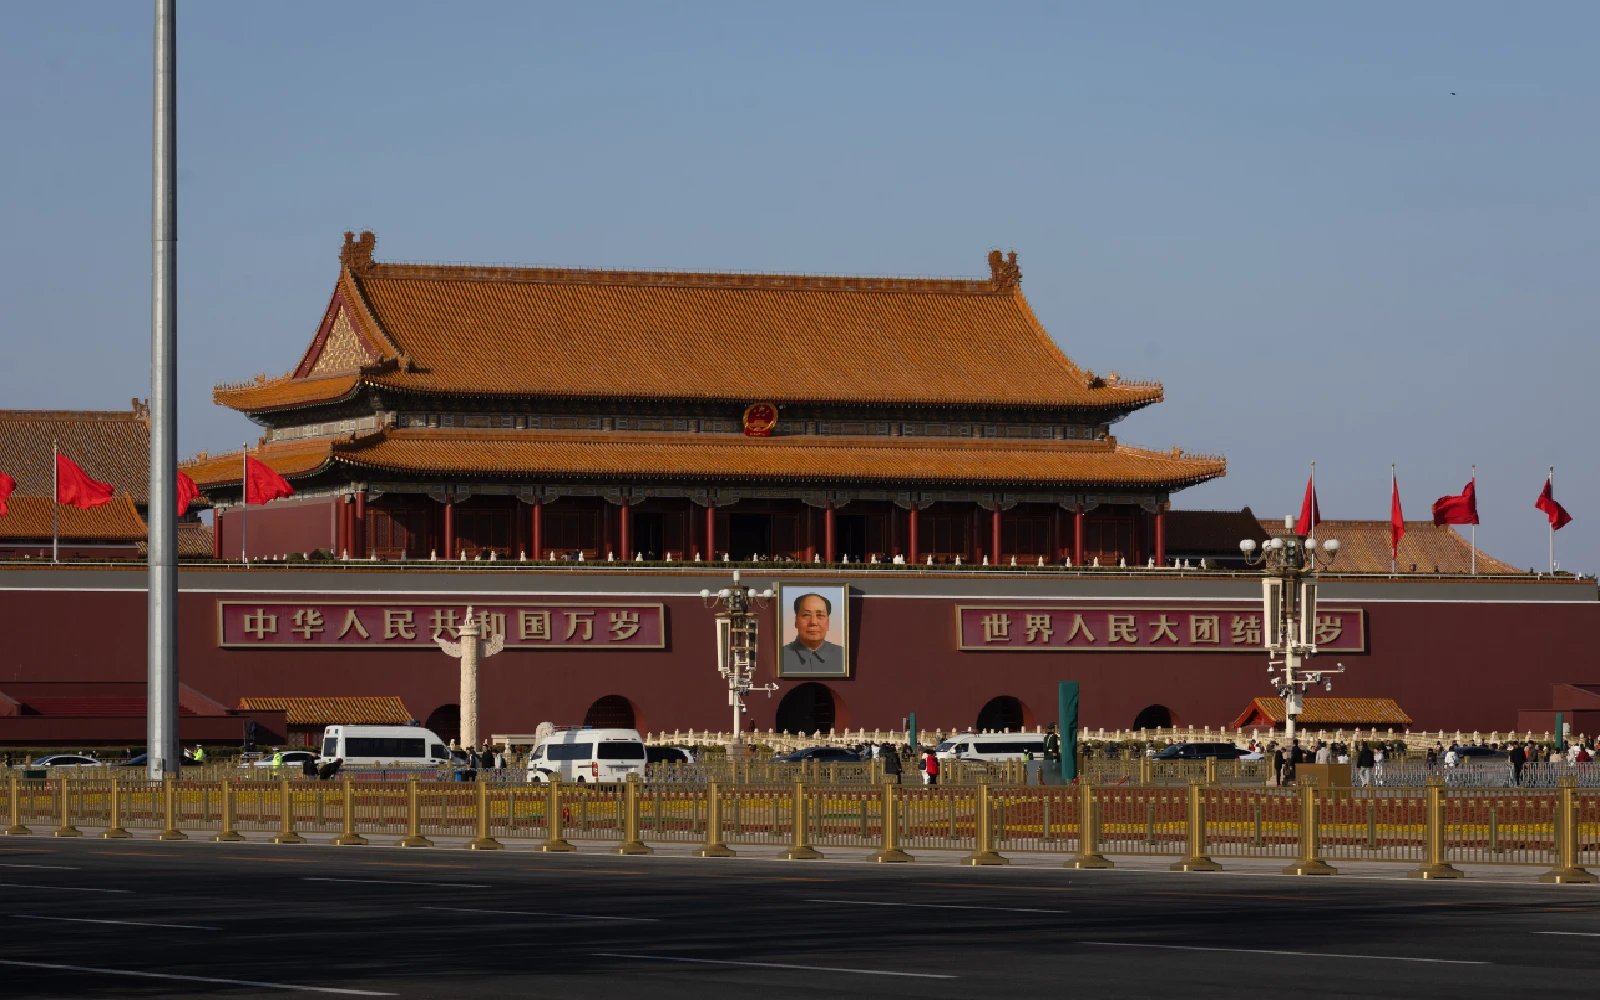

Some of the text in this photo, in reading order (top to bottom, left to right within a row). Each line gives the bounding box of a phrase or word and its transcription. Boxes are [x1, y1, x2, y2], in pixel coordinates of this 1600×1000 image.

[243, 608, 640, 640] 中华人民共和国万岁
